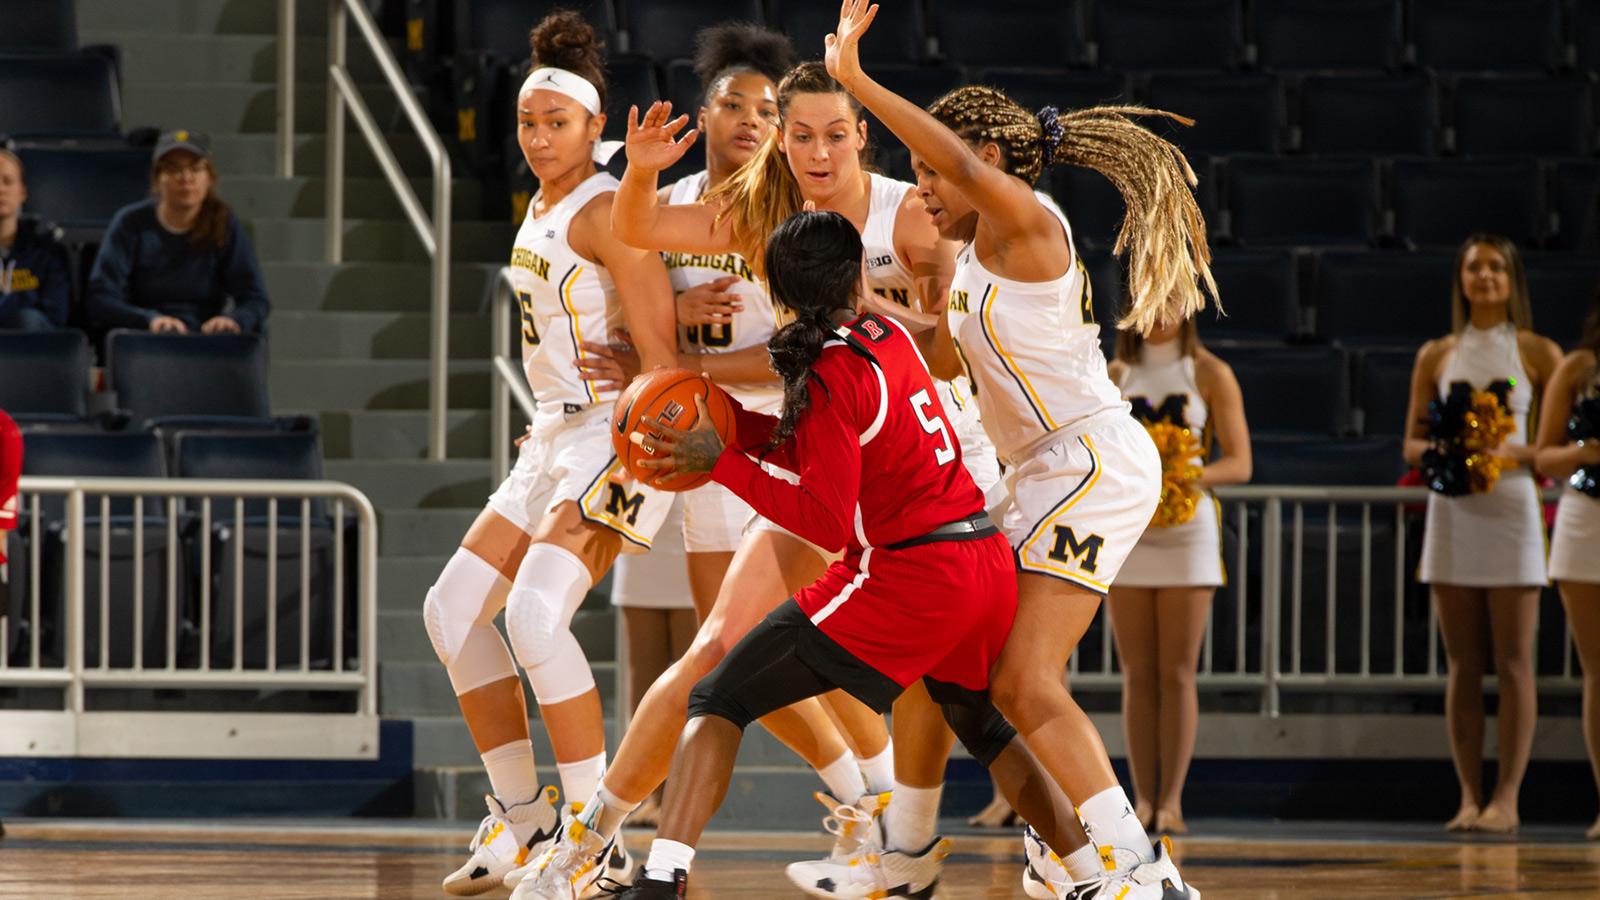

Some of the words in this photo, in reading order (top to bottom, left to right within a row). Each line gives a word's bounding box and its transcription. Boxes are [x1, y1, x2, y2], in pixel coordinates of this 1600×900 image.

[861, 319, 884, 340] R
[908, 387, 957, 467] 5
[605, 480, 646, 527] M
[1047, 524, 1105, 575] M
